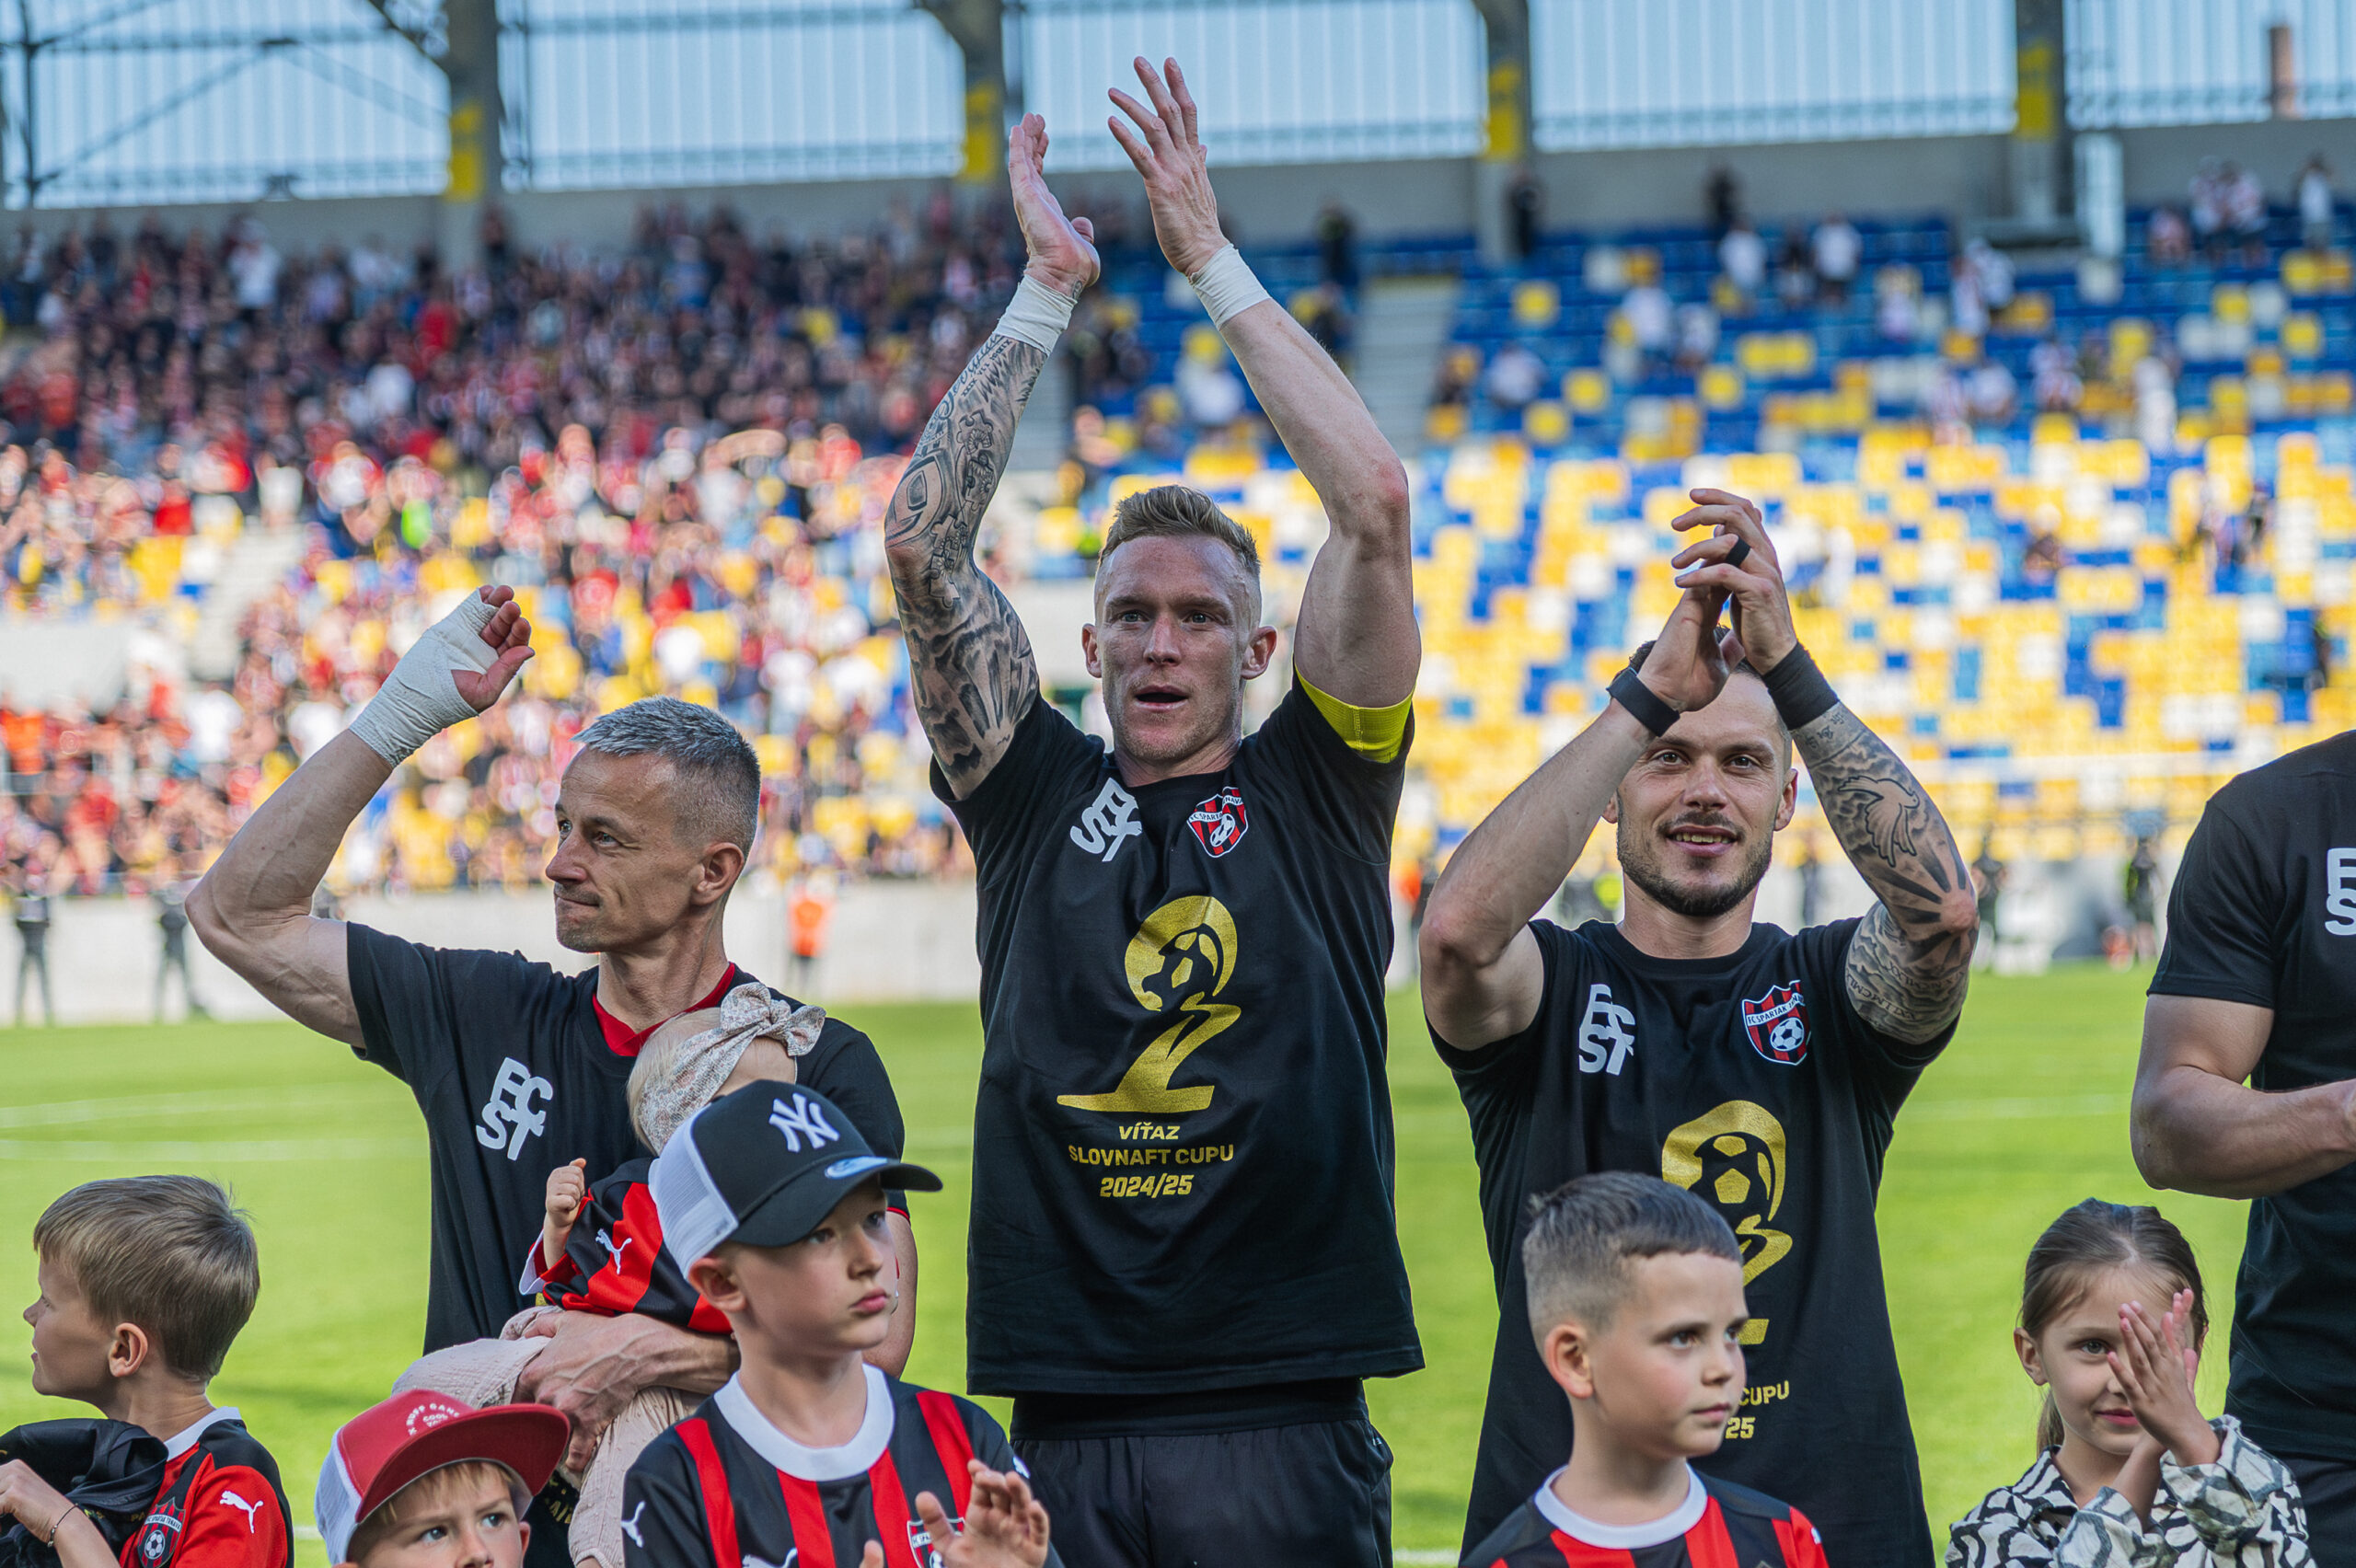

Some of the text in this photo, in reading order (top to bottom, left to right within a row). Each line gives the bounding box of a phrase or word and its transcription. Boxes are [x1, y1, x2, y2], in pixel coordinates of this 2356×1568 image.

[1748, 1016, 1756, 1024] FC
[1756, 1006, 1787, 1023] SPARTAK
[768, 1092, 840, 1153] NY
[1118, 1122, 1181, 1140] VÍŤAZ
[1068, 1144, 1234, 1166] SLOVNAFT CUPU
[1100, 1173, 1195, 1198] 2024/25
